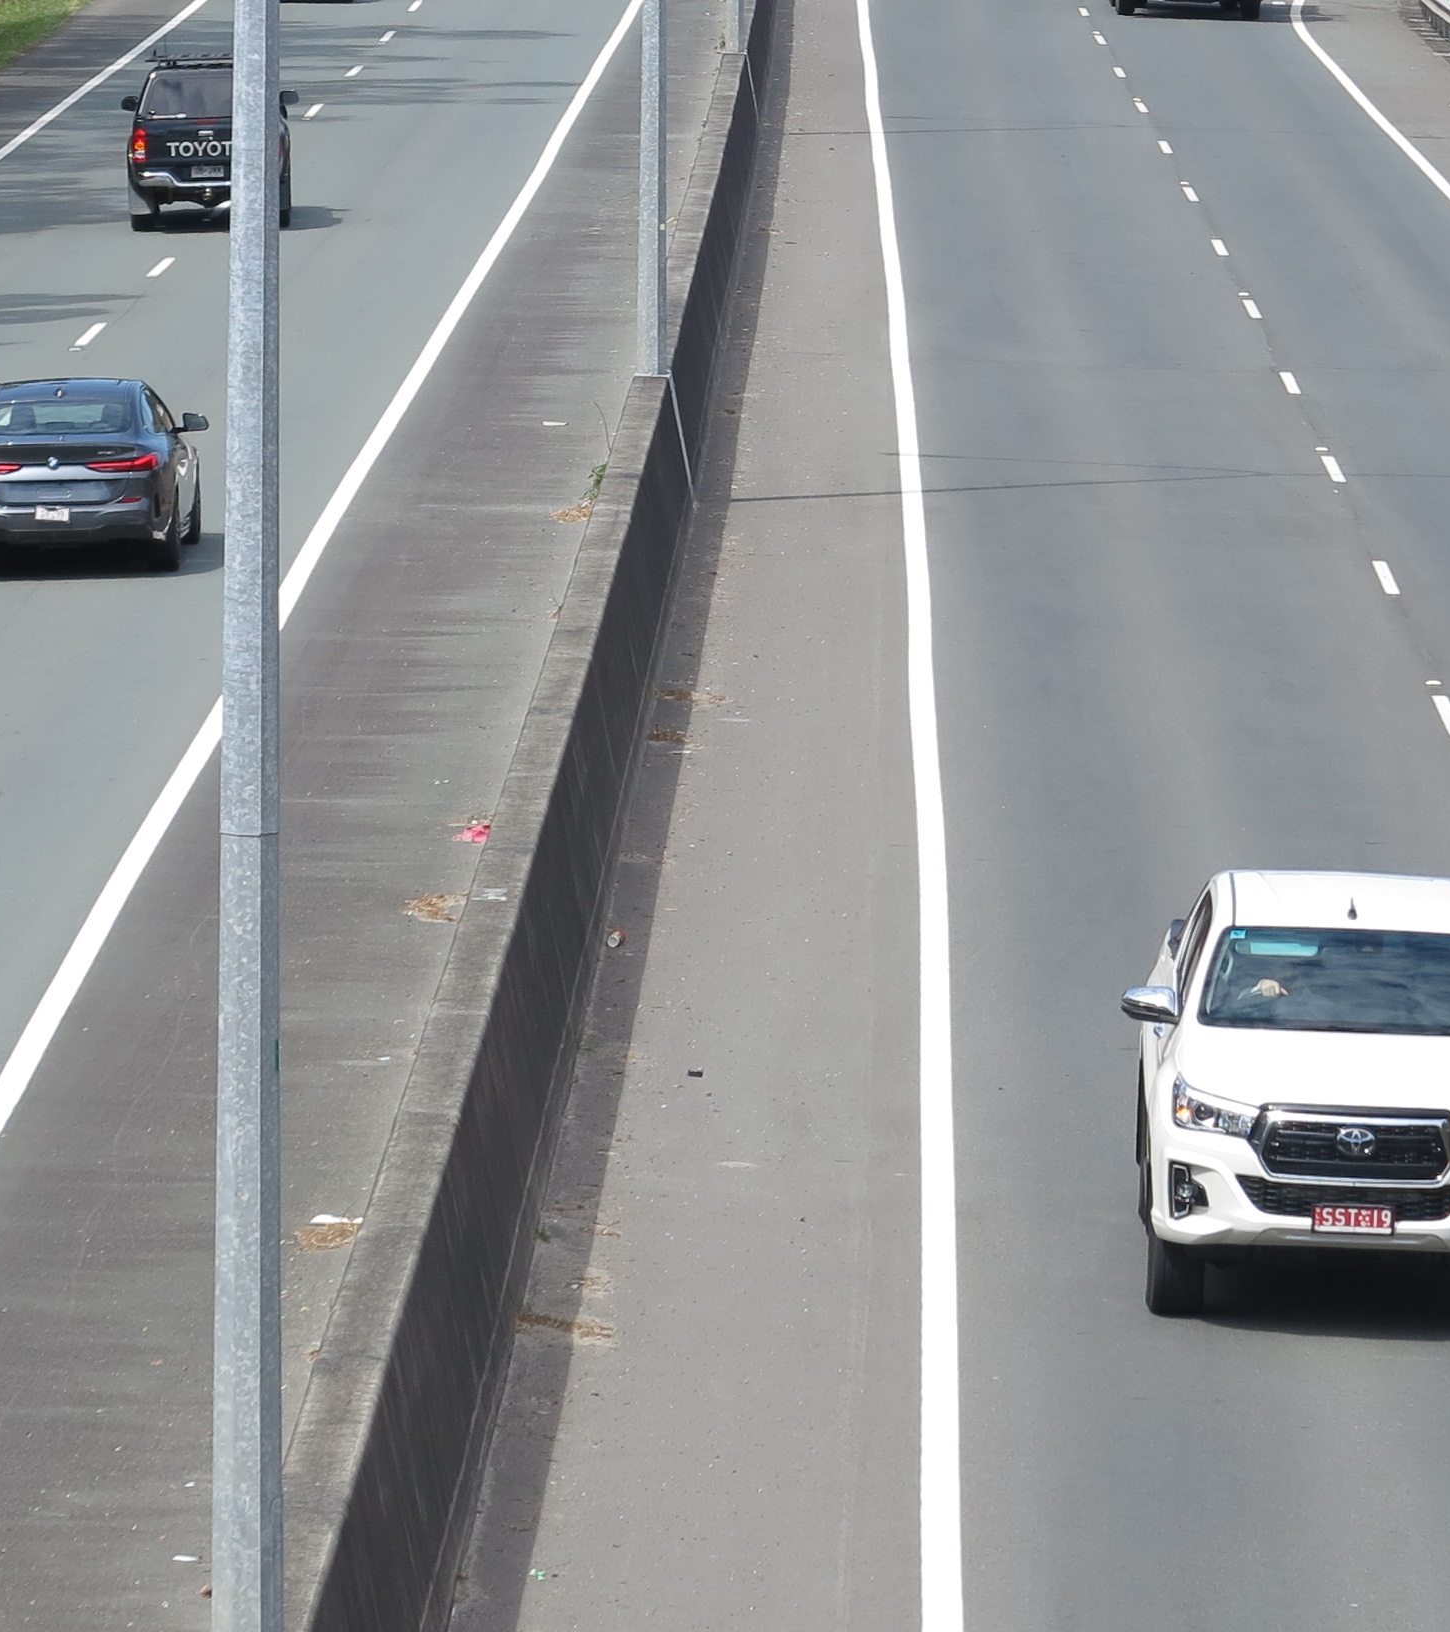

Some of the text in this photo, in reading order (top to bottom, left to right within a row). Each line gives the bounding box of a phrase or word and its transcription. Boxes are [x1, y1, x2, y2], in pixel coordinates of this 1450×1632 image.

[166, 141, 232, 157] TOYOT
[1322, 1207, 1359, 1226] SST
[1373, 1209, 1392, 1228] 19
